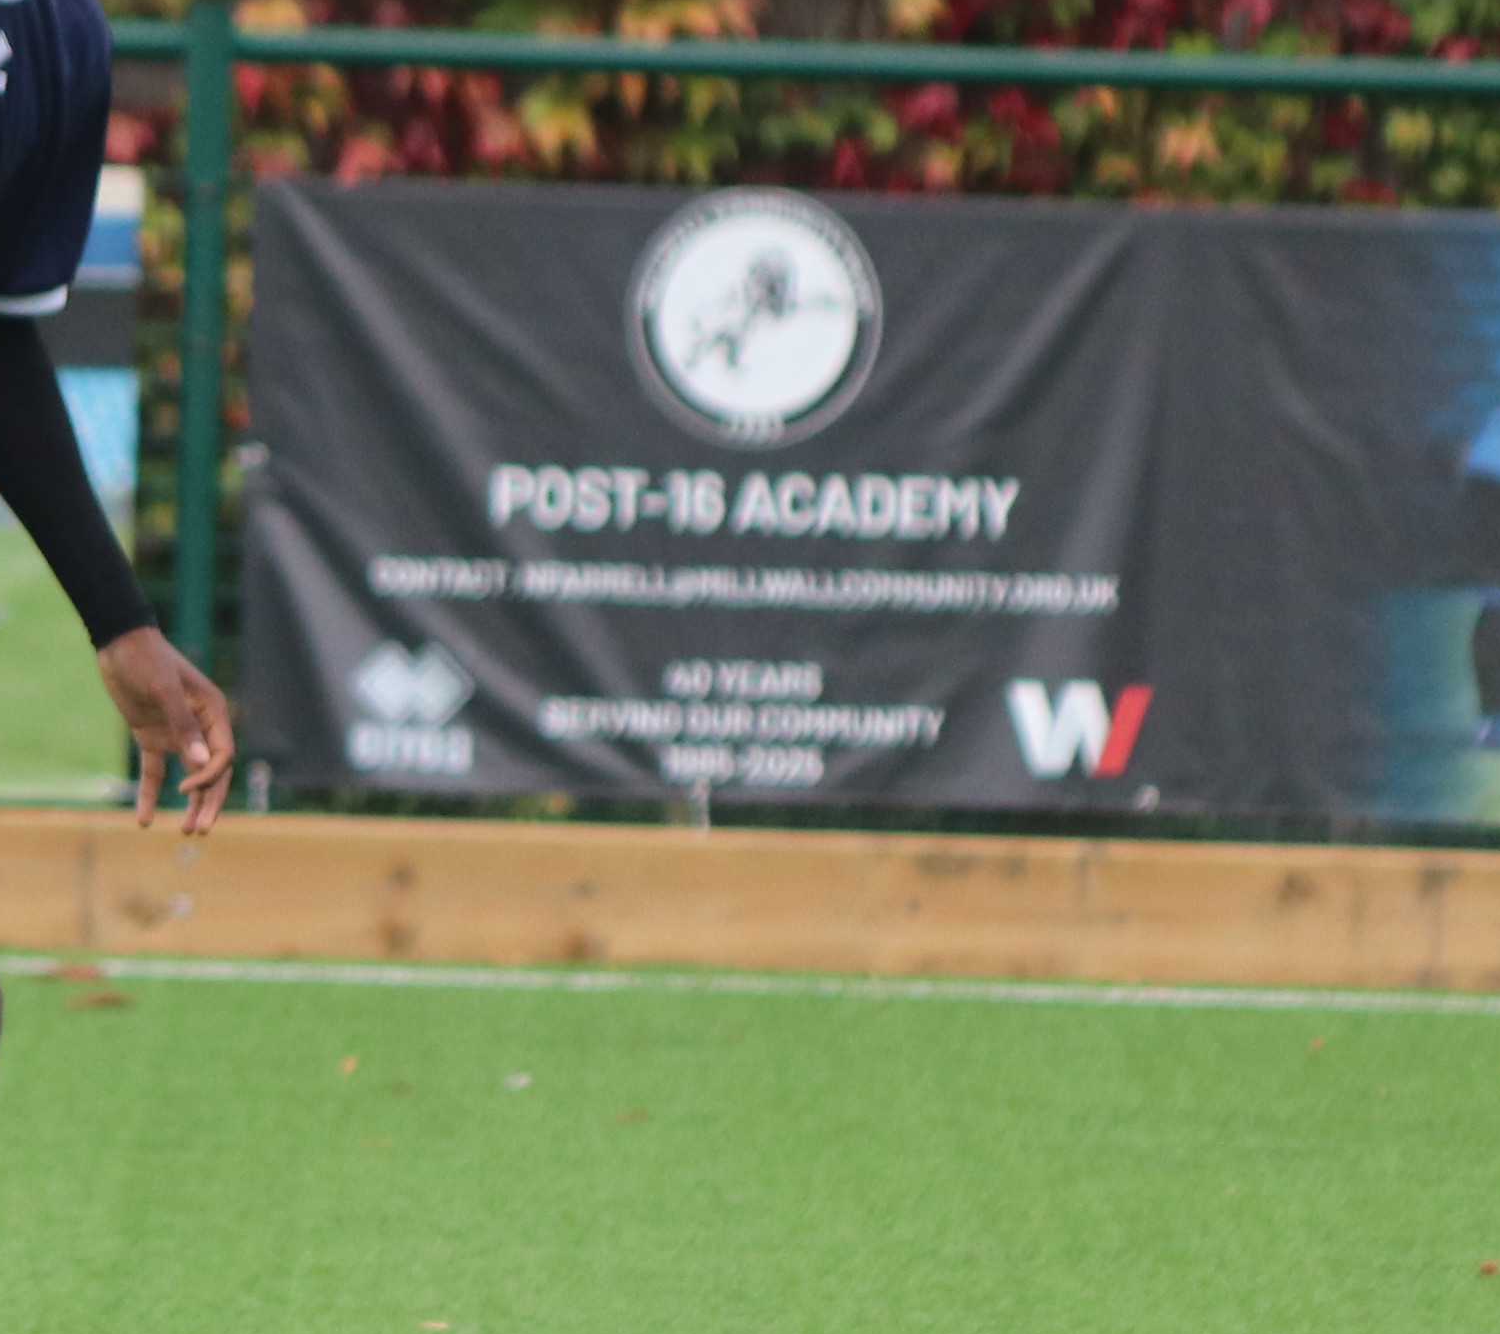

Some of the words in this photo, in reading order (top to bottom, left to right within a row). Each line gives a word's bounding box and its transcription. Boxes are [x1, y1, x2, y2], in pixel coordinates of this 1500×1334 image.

[488, 463, 727, 535] POST-16
[730, 471, 1021, 543] ACADEMY
[715, 660, 824, 704] YEARS
[538, 694, 683, 743] SERVING
[684, 699, 755, 743] OUR
[756, 702, 946, 748] COMMUNITY
